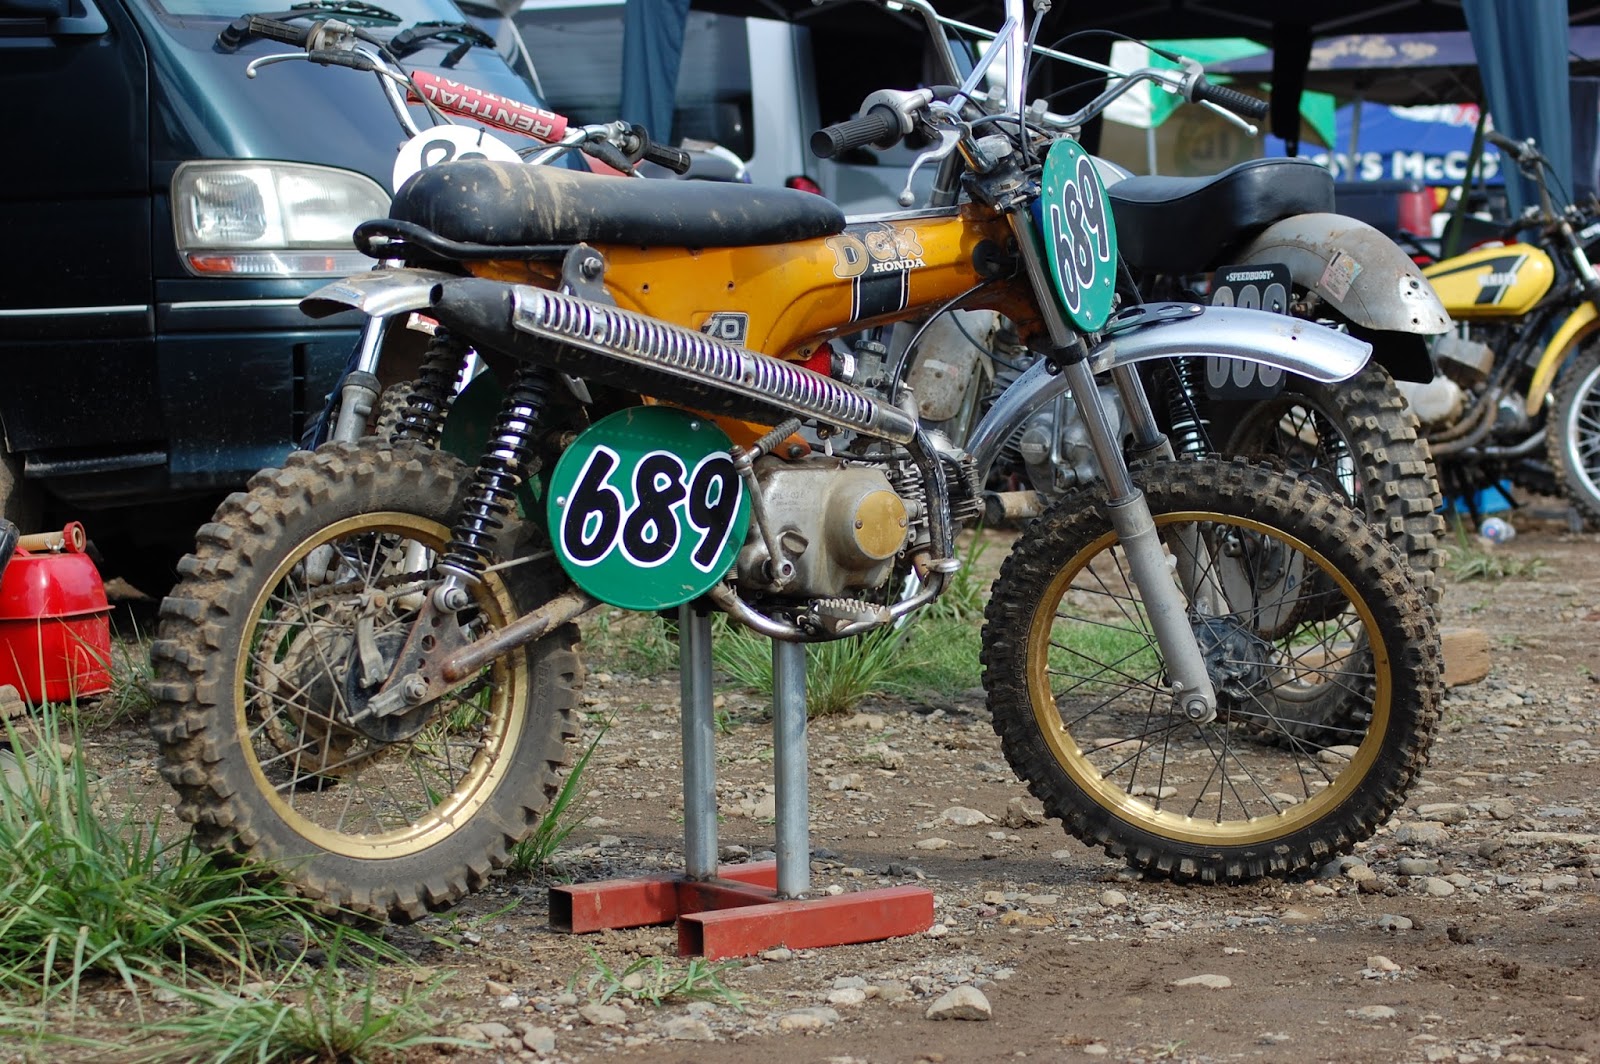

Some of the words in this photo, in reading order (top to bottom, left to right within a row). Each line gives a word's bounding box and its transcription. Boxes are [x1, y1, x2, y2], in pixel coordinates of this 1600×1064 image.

[424, 84, 553, 138] RENTHAL
[1050, 154, 1110, 314] 689
[872, 258, 926, 273] HONDA
[1228, 270, 1272, 282] SPEEDBUGGY
[560, 445, 742, 573] 689
